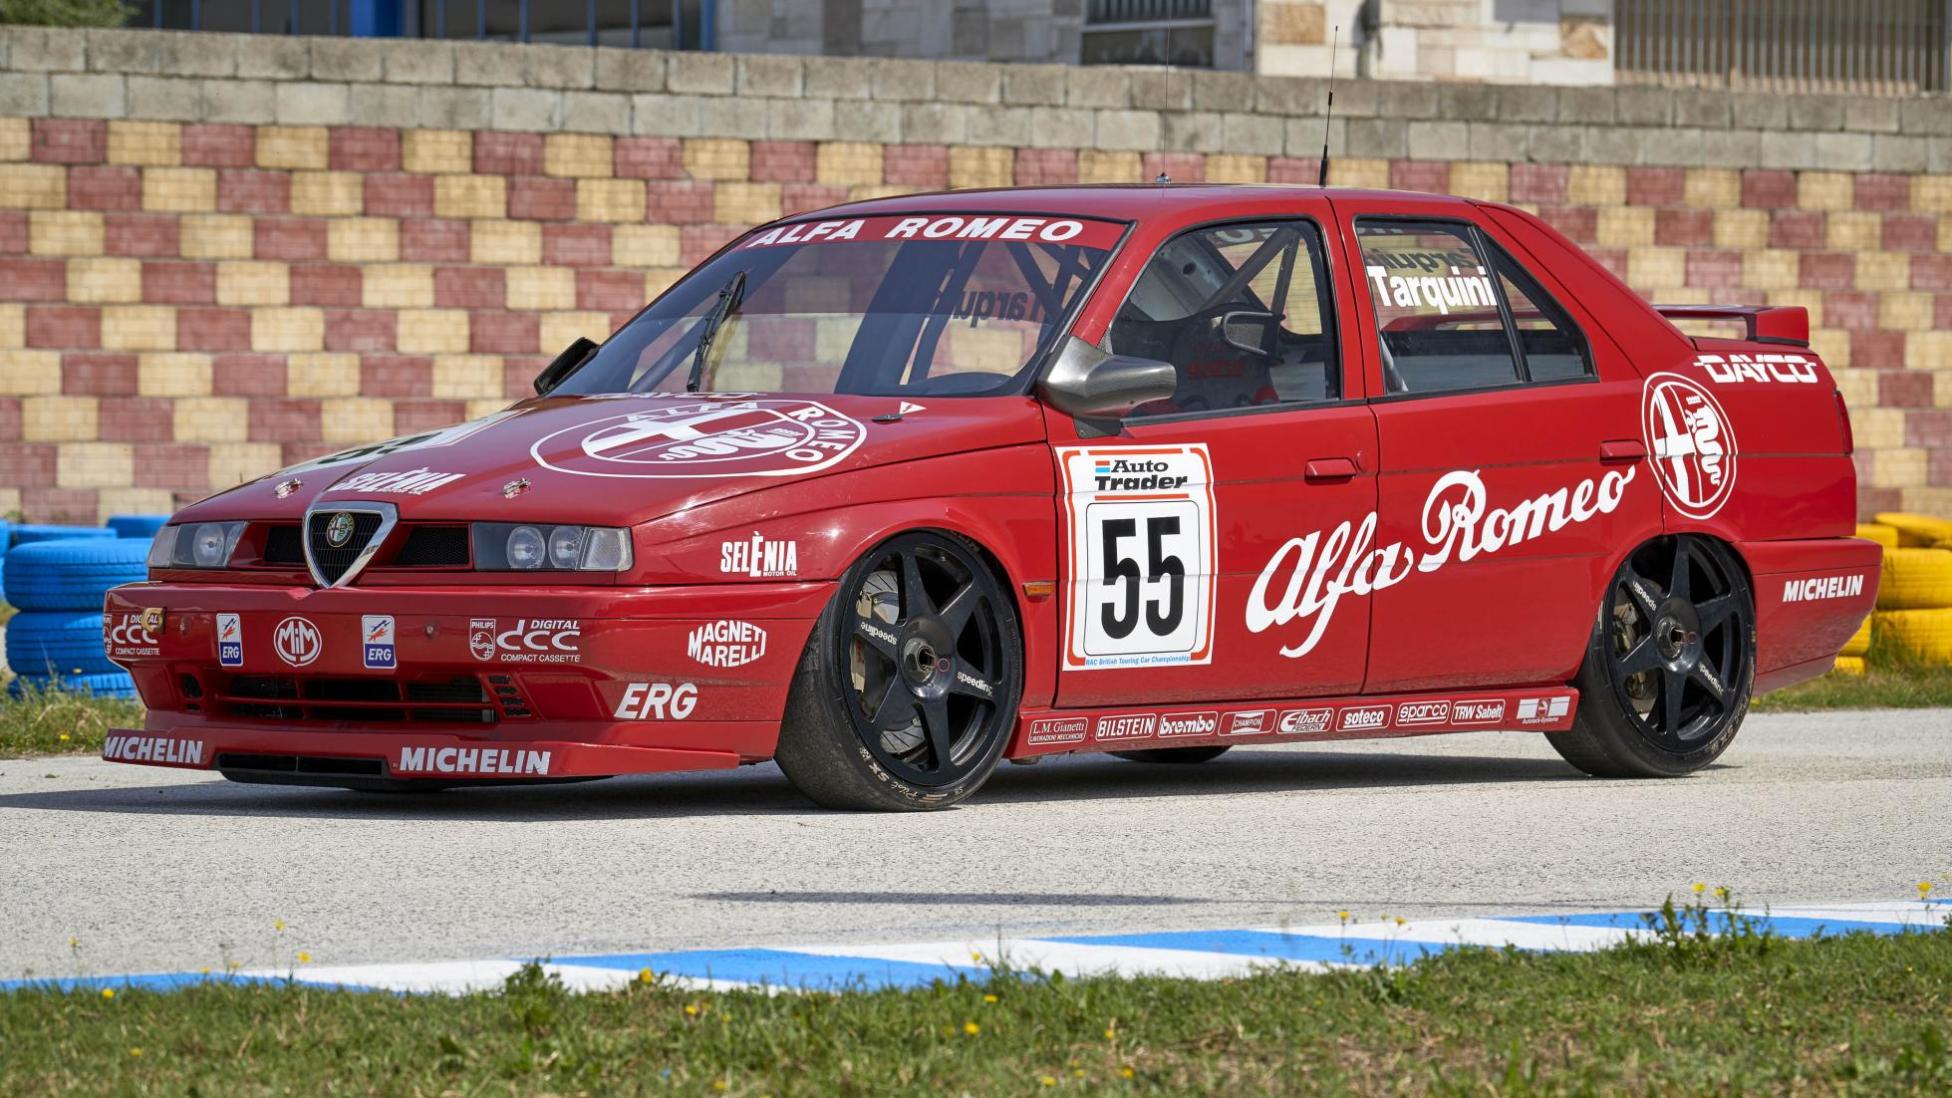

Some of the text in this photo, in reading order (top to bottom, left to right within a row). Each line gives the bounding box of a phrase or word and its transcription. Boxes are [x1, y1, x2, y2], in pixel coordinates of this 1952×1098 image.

[750, 217, 1084, 246] ALFA ROMEO
[1366, 265, 1498, 315] Tarquini
[1693, 354, 1817, 383] DAYCO
[786, 406, 857, 462] ROMEO
[1111, 460, 1169, 473] Auto
[1094, 475, 1188, 491] Trader
[720, 531, 798, 577] SELÈNIA
[1245, 465, 1636, 658] Alfa Romeo
[1101, 516, 1186, 640] 55
[1782, 574, 1865, 602] MICHELIN
[471, 621, 494, 629] PHILIPS
[530, 620, 580, 629] DIGITAL
[861, 621, 897, 645] speedline
[688, 620, 767, 660] MAGNETI
[688, 628, 767, 667] MARELLI
[222, 646, 240, 659] ERG
[368, 648, 392, 661] ERG
[500, 654, 581, 662] COMPACT CASSETTE
[613, 683, 698, 719] ERG
[1400, 703, 1448, 719] sparco
[1454, 705, 1476, 720] TRW
[1097, 718, 1154, 736] BILSTEIN
[1159, 715, 1214, 734] brembo
[1281, 710, 1330, 731] Eibach
[1345, 711, 1383, 724] soteco
[104, 736, 203, 764] MICHELIN
[400, 747, 551, 775] MICHELIN
